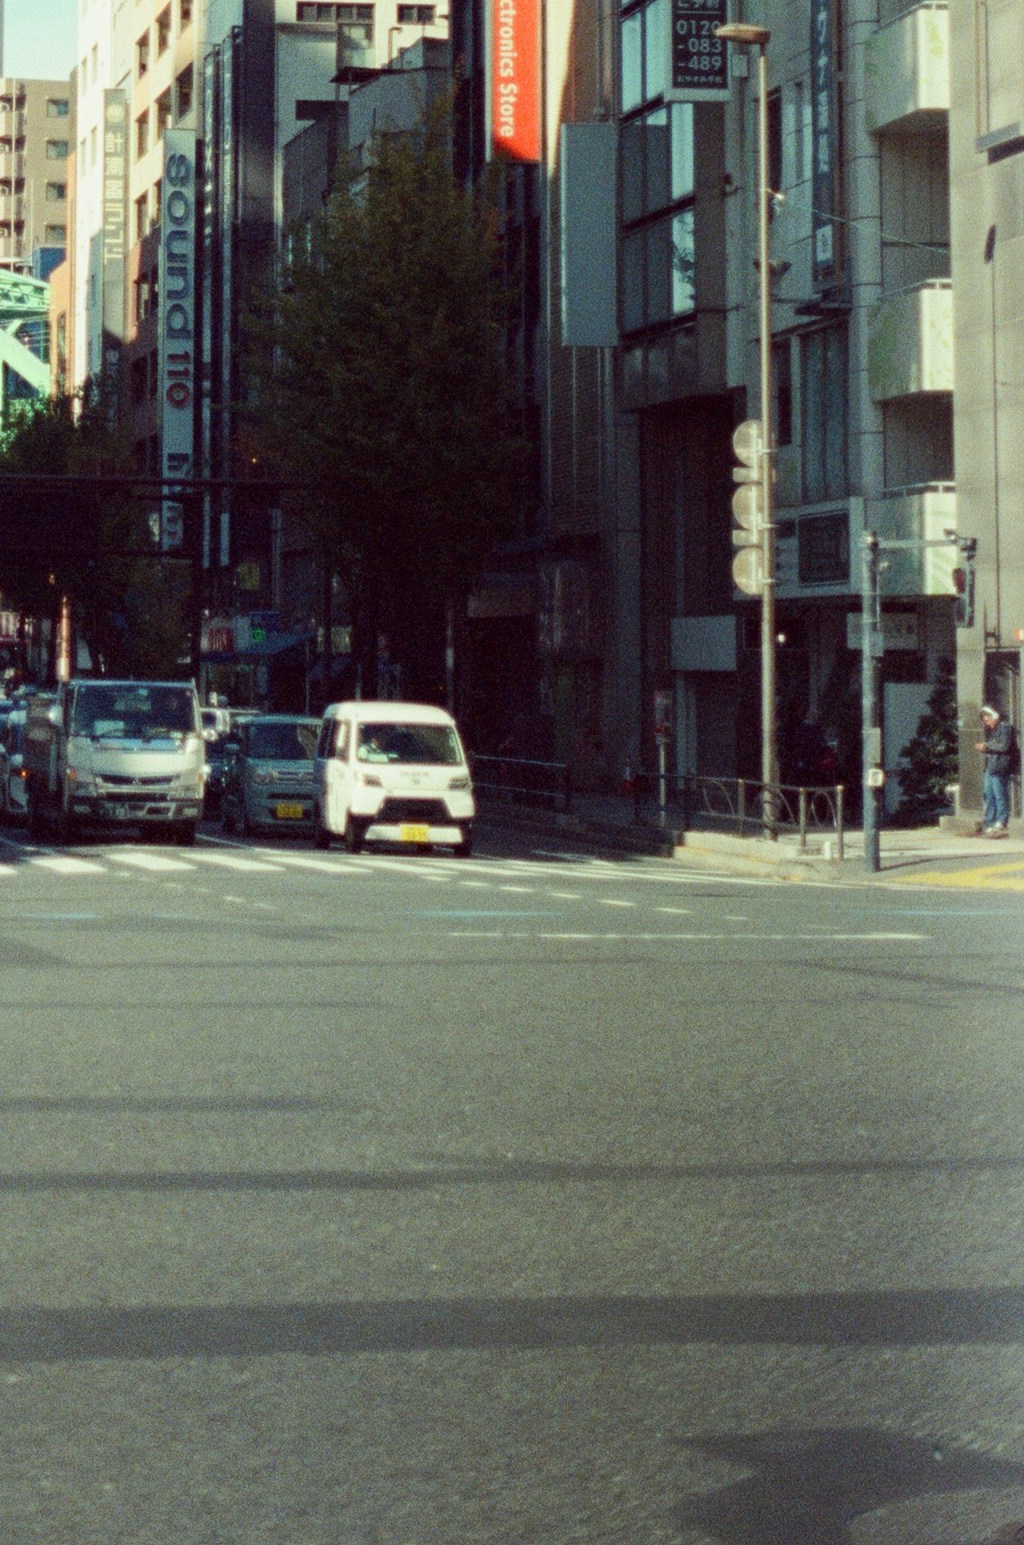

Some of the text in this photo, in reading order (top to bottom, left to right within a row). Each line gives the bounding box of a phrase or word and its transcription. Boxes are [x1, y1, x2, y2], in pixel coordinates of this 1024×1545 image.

[499, 82, 517, 137] Store
[166, 153, 193, 409] sound 110
